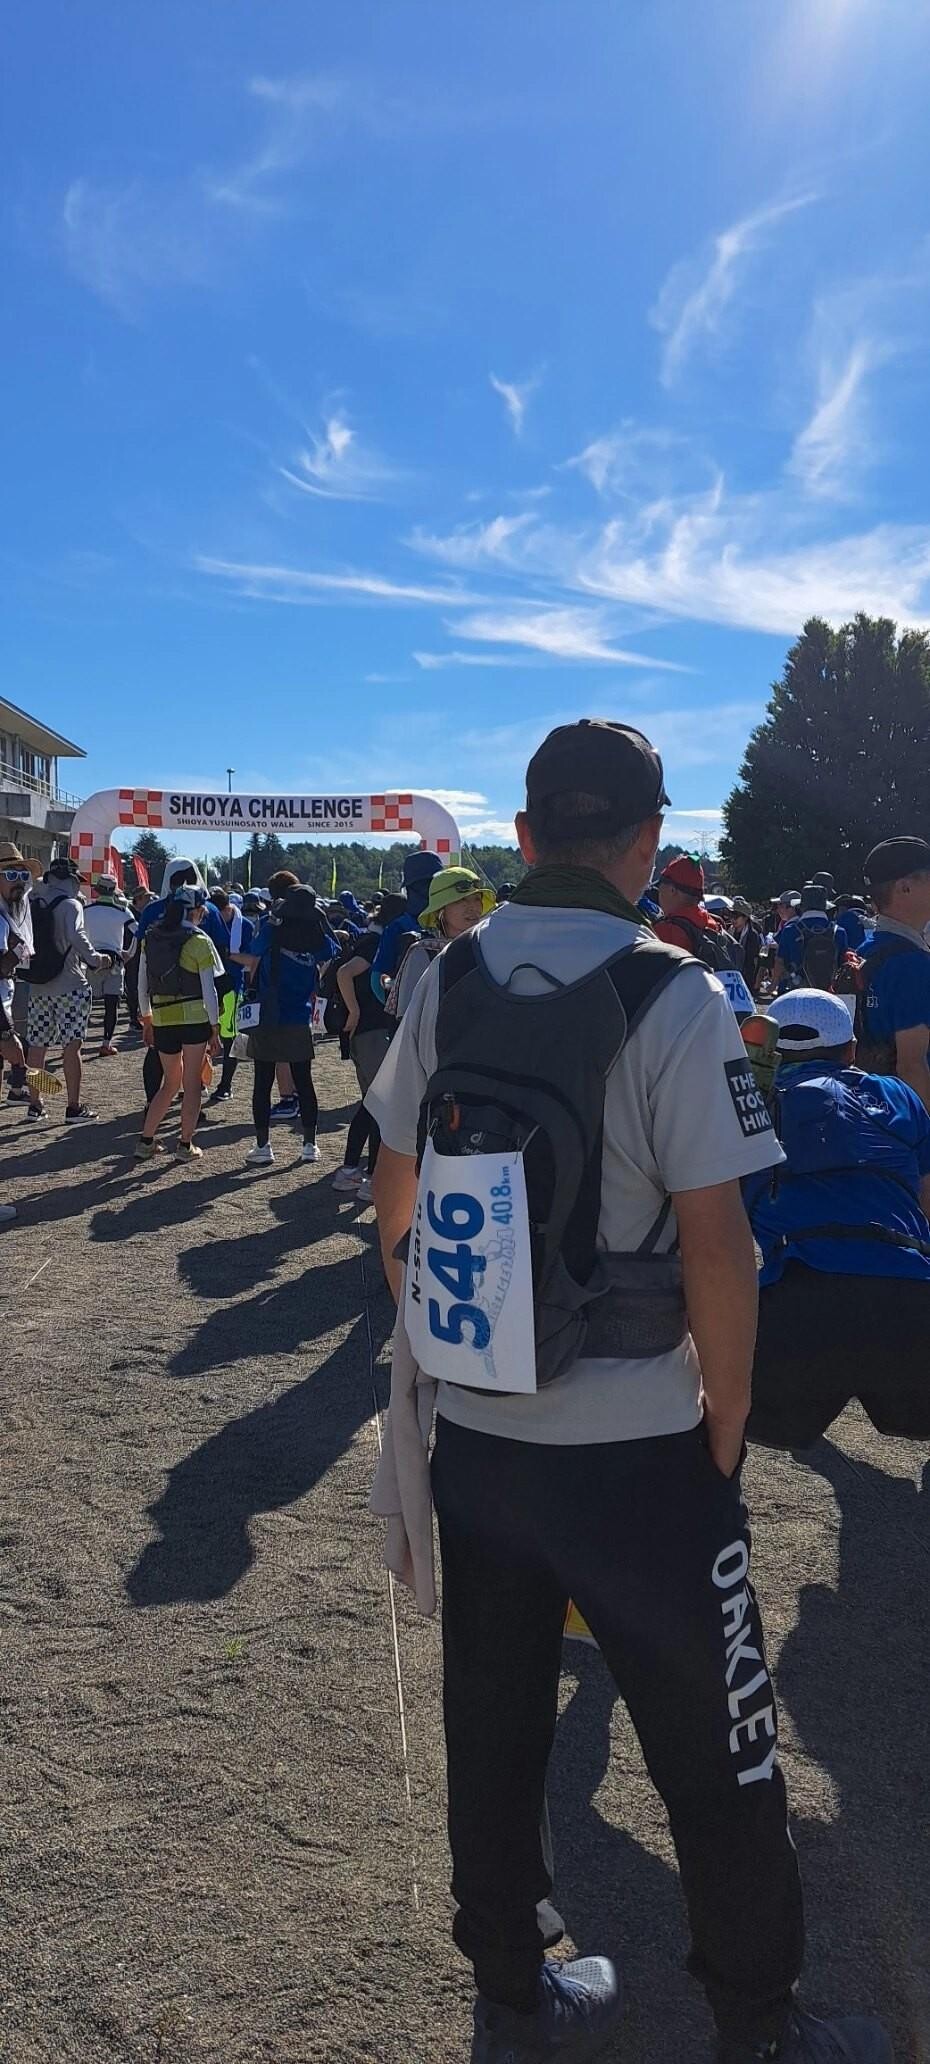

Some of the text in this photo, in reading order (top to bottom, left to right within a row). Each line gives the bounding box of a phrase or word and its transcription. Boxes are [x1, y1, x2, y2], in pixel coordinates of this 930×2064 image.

[169, 795, 363, 819] SHIOYA CHALLENGE
[176, 818, 208, 826] SHIOYA
[209, 819, 268, 828] YUSUINOSATO
[427, 1190, 491, 1350] 546
[711, 1539, 778, 1786] OAKLEY
